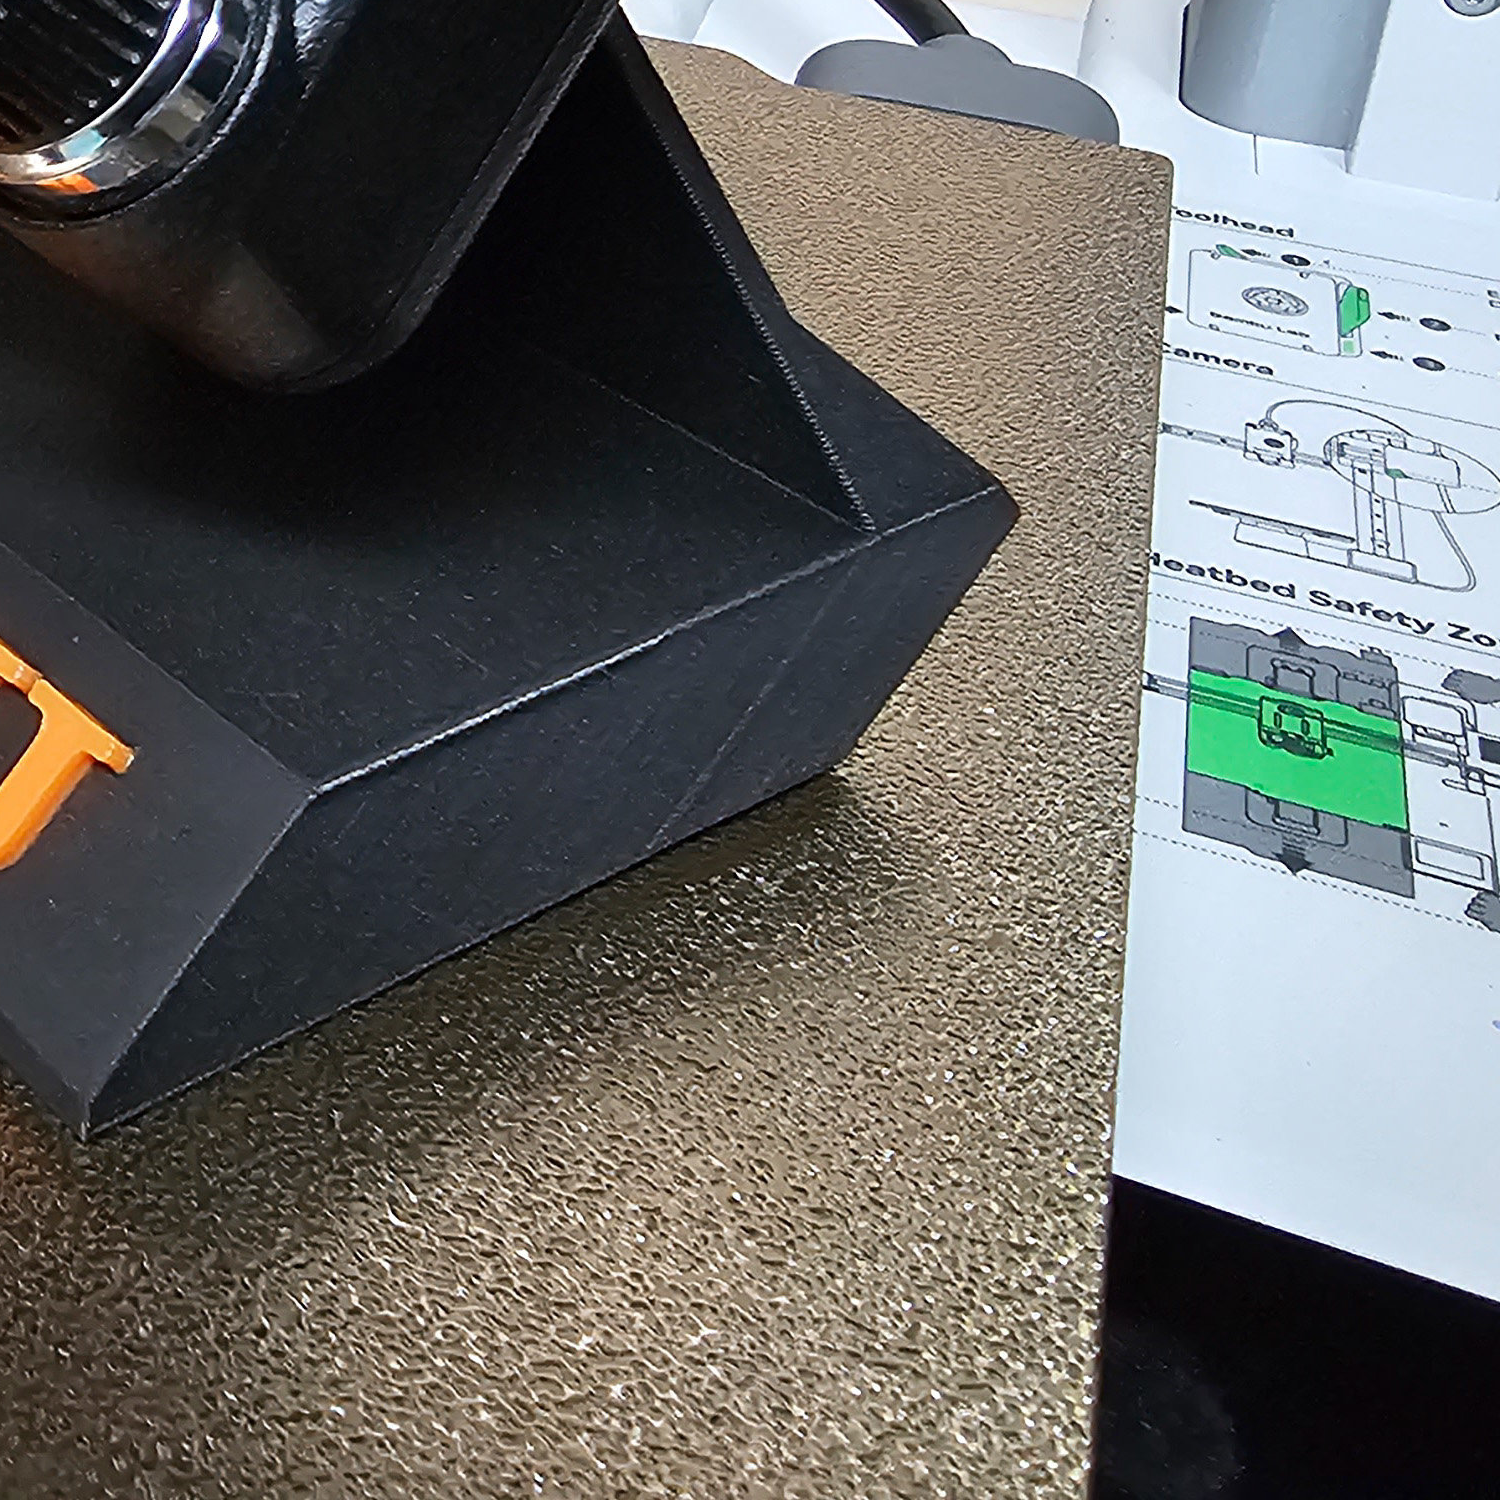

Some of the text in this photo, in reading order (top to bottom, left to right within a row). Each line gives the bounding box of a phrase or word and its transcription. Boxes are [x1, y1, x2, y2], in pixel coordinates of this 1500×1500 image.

[1171, 204, 1294, 238] oolhead
[1309, 590, 1435, 635] Safety
[1447, 622, 1500, 647] Zo
